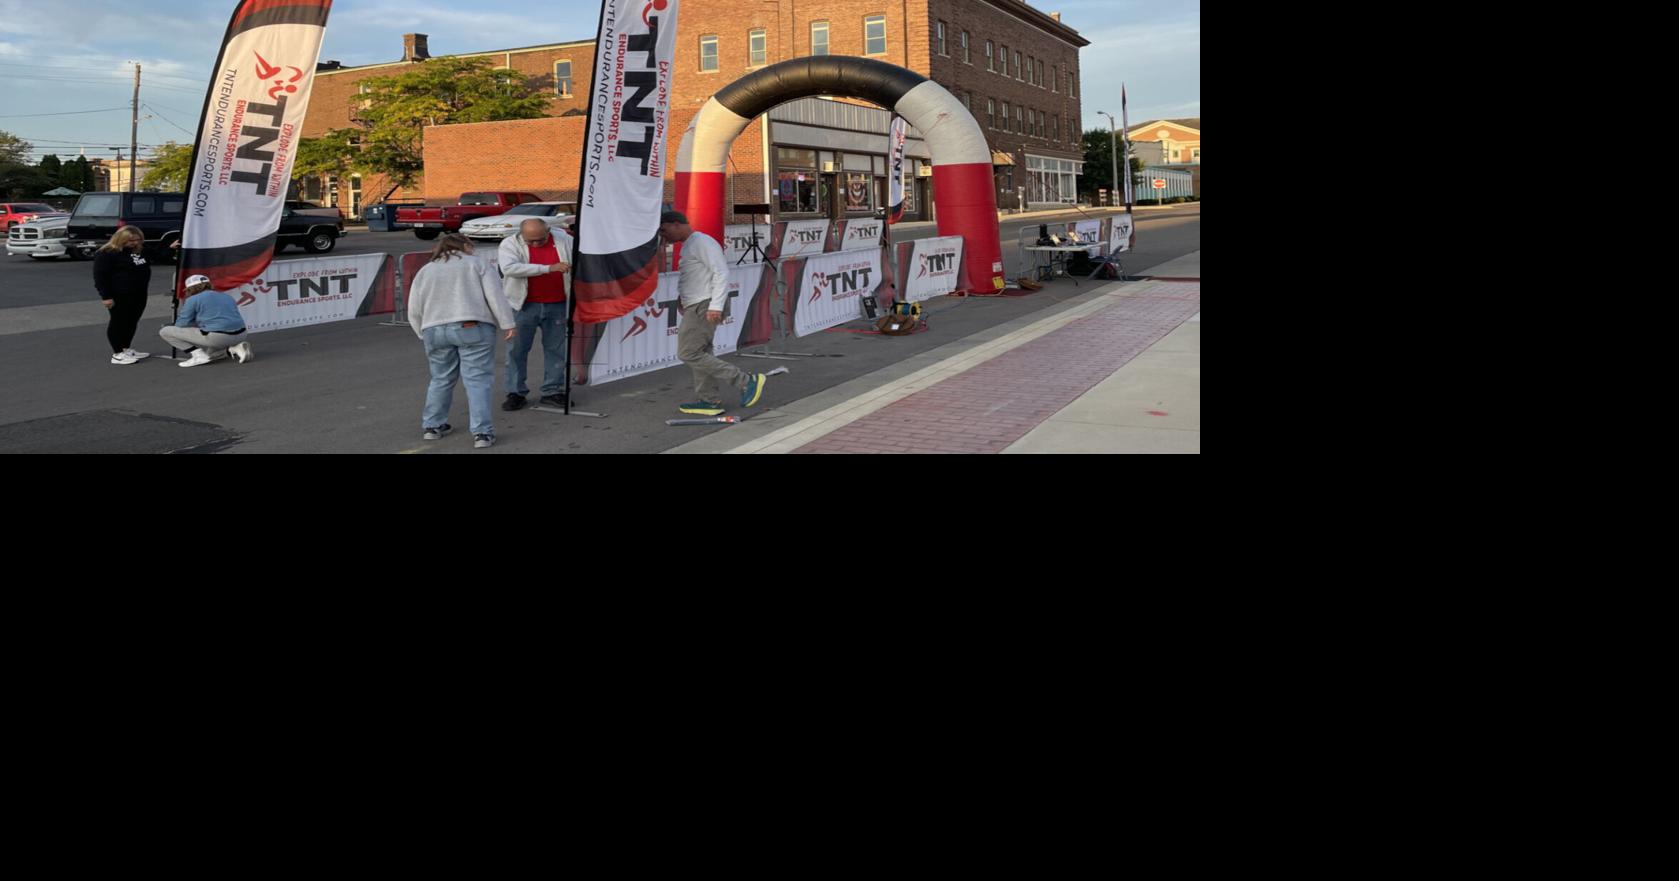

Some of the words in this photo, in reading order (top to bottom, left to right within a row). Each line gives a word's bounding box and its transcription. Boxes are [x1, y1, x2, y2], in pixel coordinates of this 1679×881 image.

[613, 33, 627, 98] ENDURANCE
[615, 15, 659, 176] TNT
[227, 99, 247, 143] ENDURANCE
[655, 110, 665, 138] FROM
[193, 68, 238, 218] TNTENDURANCESPORTS.COM
[230, 94, 288, 196] TNT
[278, 122, 294, 154] EXPLODE
[274, 154, 287, 173] FROM
[607, 144, 616, 162] LLC
[649, 142, 660, 178] WITHIN
[218, 172, 230, 186] LLC
[267, 173, 282, 198] WITHIN
[797, 229, 824, 242] TNT
[857, 225, 879, 238] TNT
[1082, 231, 1097, 242] TNT
[1116, 225, 1129, 237] TNT
[926, 252, 956, 273] TNT
[266, 273, 358, 301] TNT
[826, 267, 873, 295] TNT
[277, 297, 316, 307] ENDURANCE
[658, 290, 739, 328] TT
